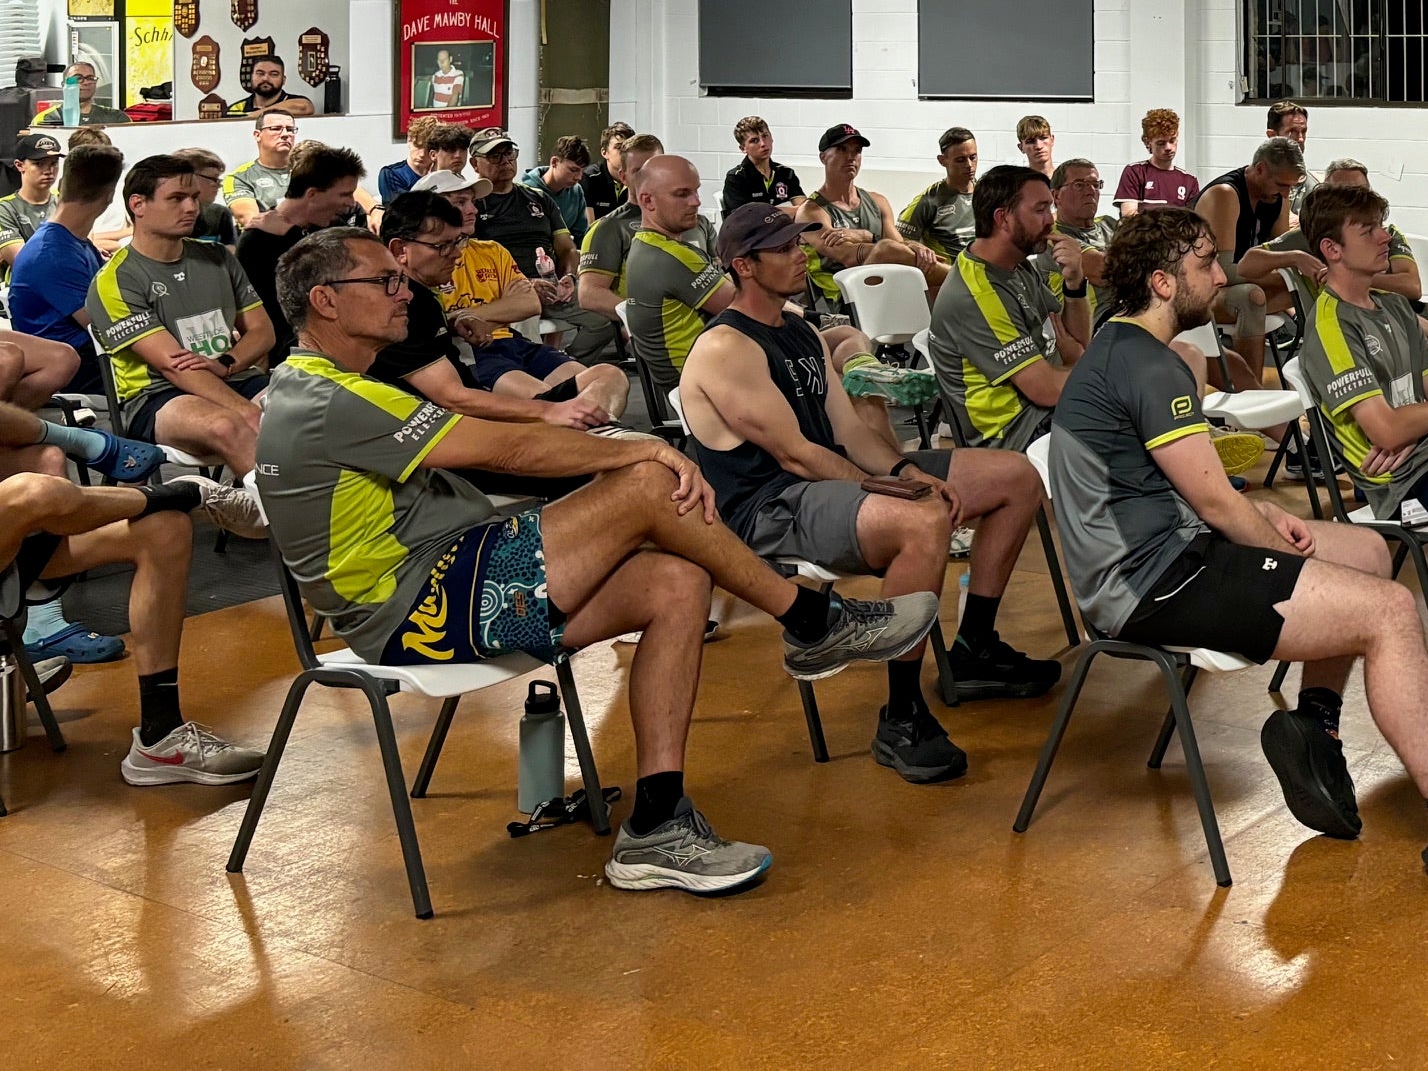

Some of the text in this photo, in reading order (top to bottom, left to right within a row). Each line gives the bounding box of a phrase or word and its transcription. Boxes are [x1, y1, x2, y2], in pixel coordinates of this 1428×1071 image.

[403, 11, 500, 41] DAVE MAWBY HALL
[106, 311, 152, 338] POWERFULL
[1326, 367, 1373, 394] POWERFULL
[1334, 376, 1373, 398] ELECTRIX
